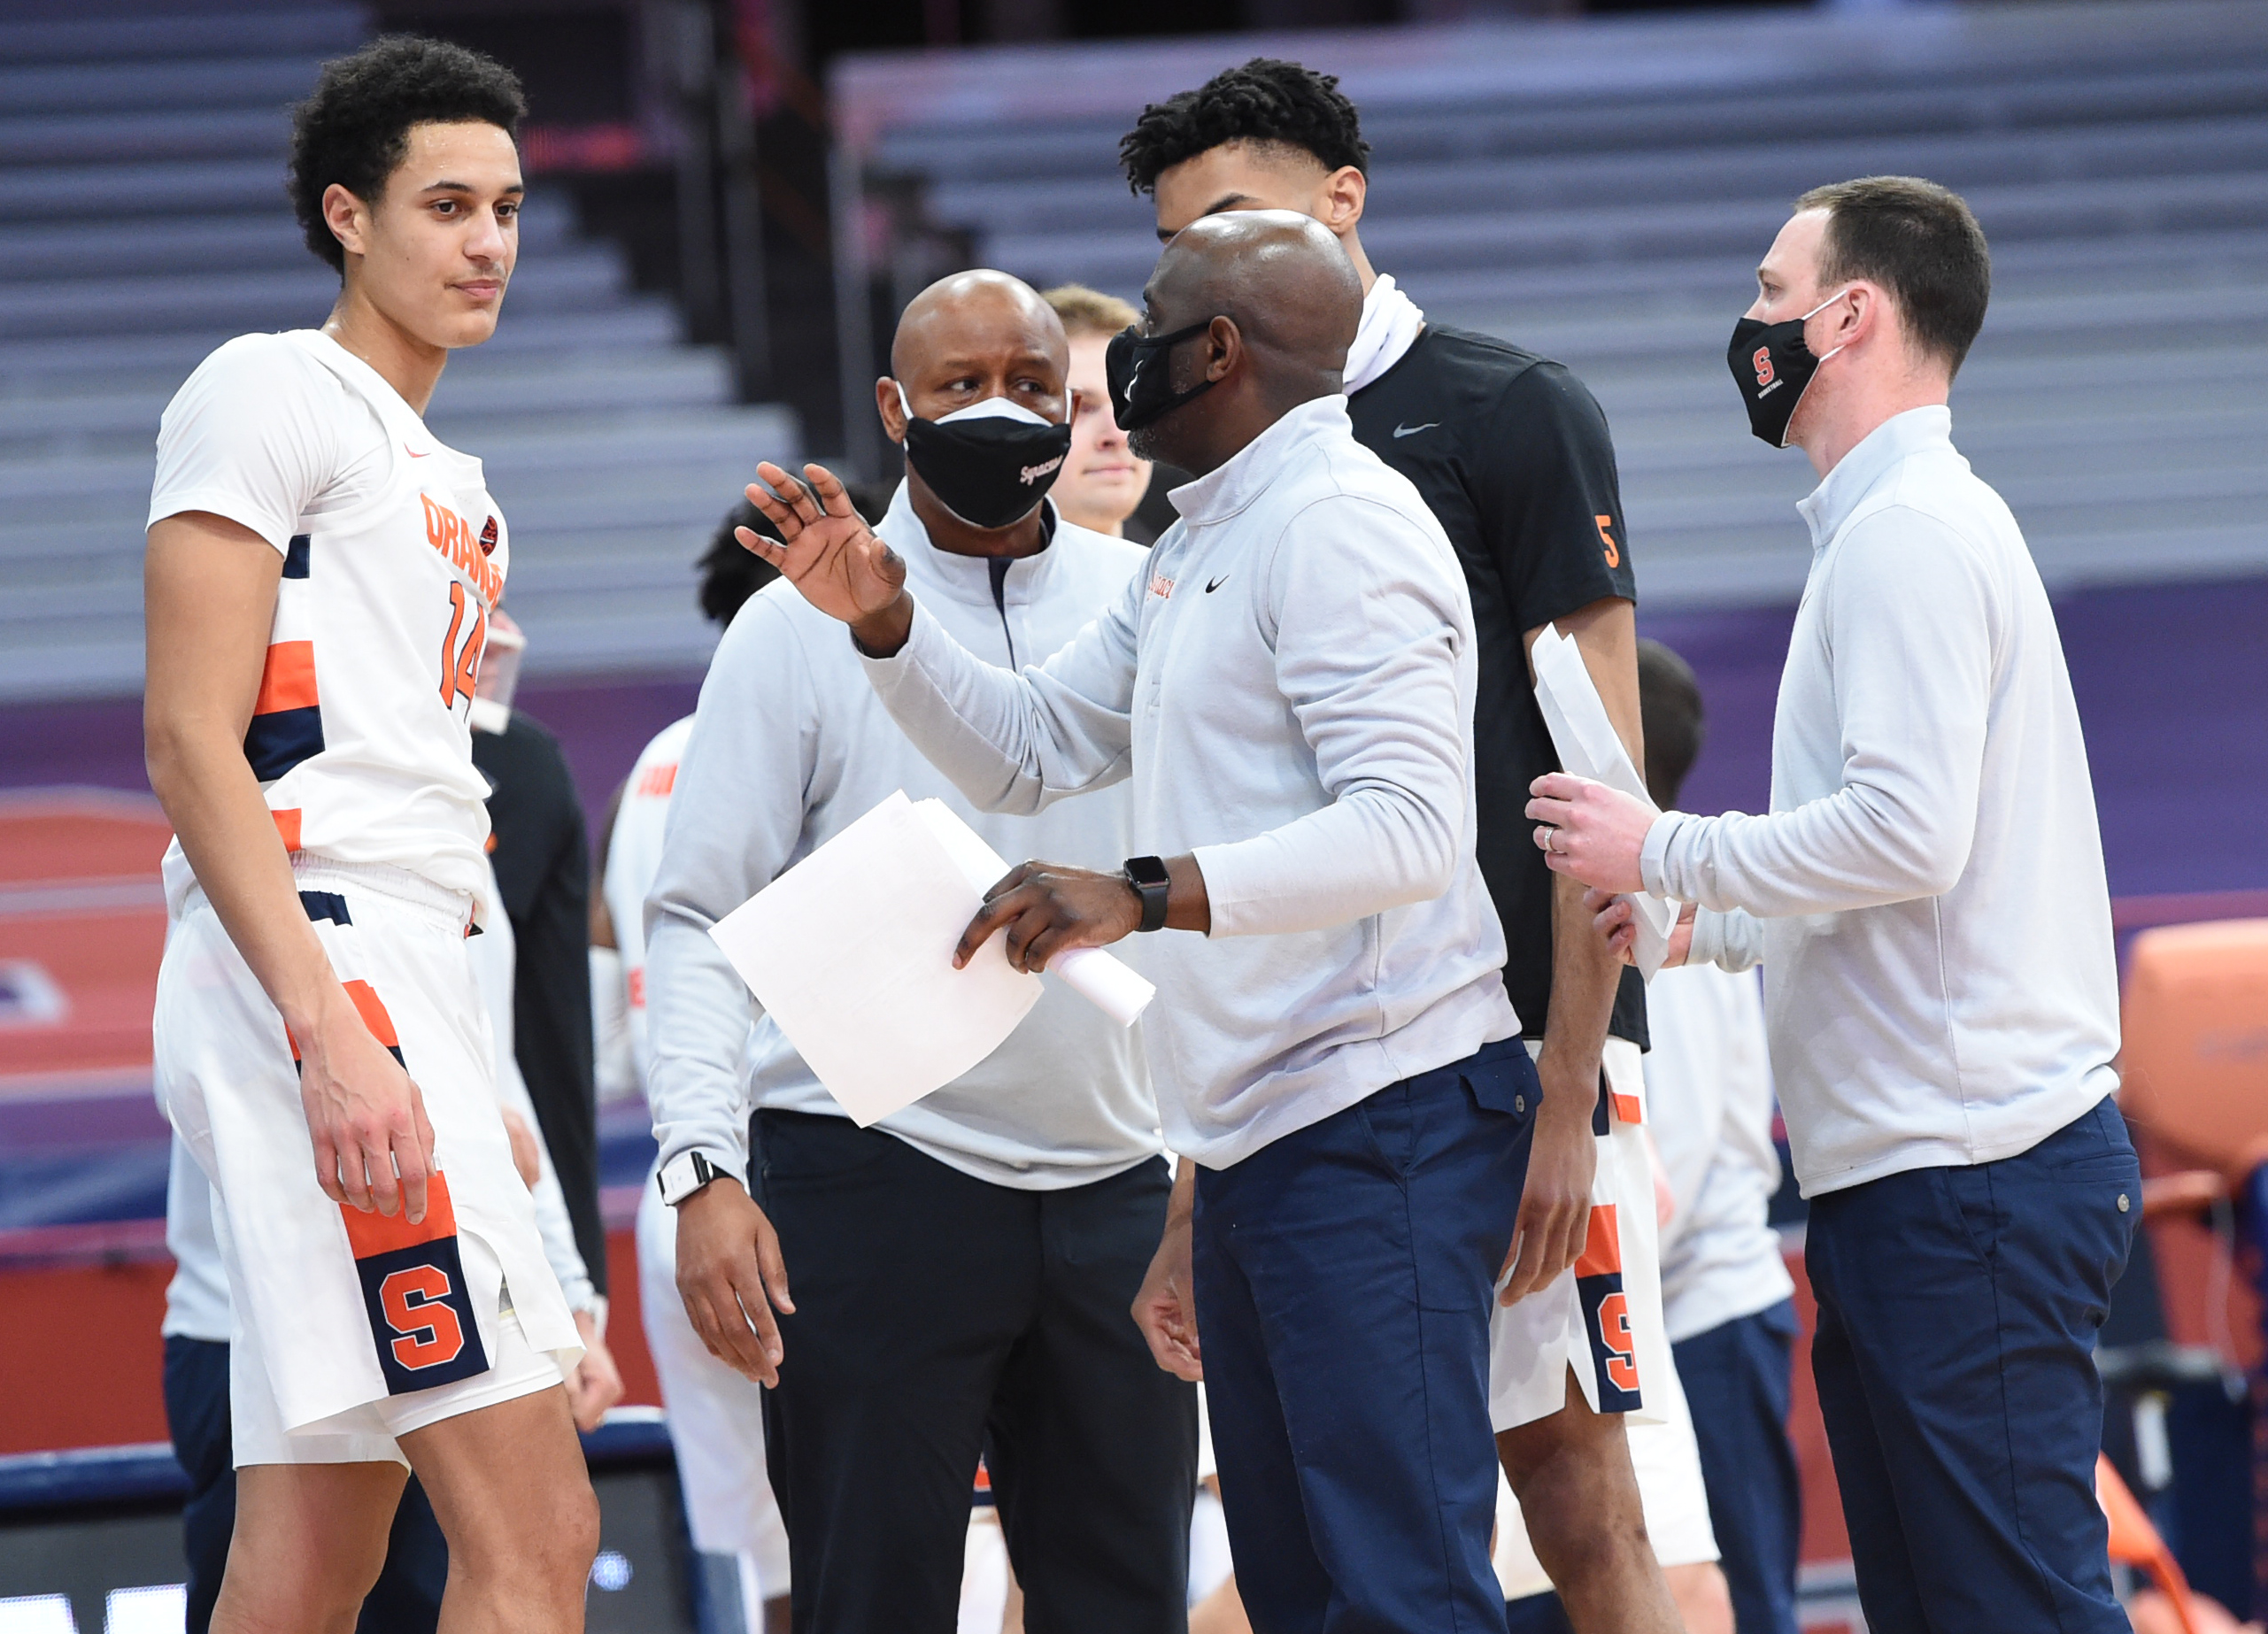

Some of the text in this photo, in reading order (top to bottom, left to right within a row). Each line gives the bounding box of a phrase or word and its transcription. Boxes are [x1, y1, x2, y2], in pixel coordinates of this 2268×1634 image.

[1753, 346, 1775, 386] S
[1594, 514, 1620, 568] 5
[439, 581, 487, 724] 14
[379, 1263, 465, 1371] S
[1597, 1292, 1639, 1391] S
